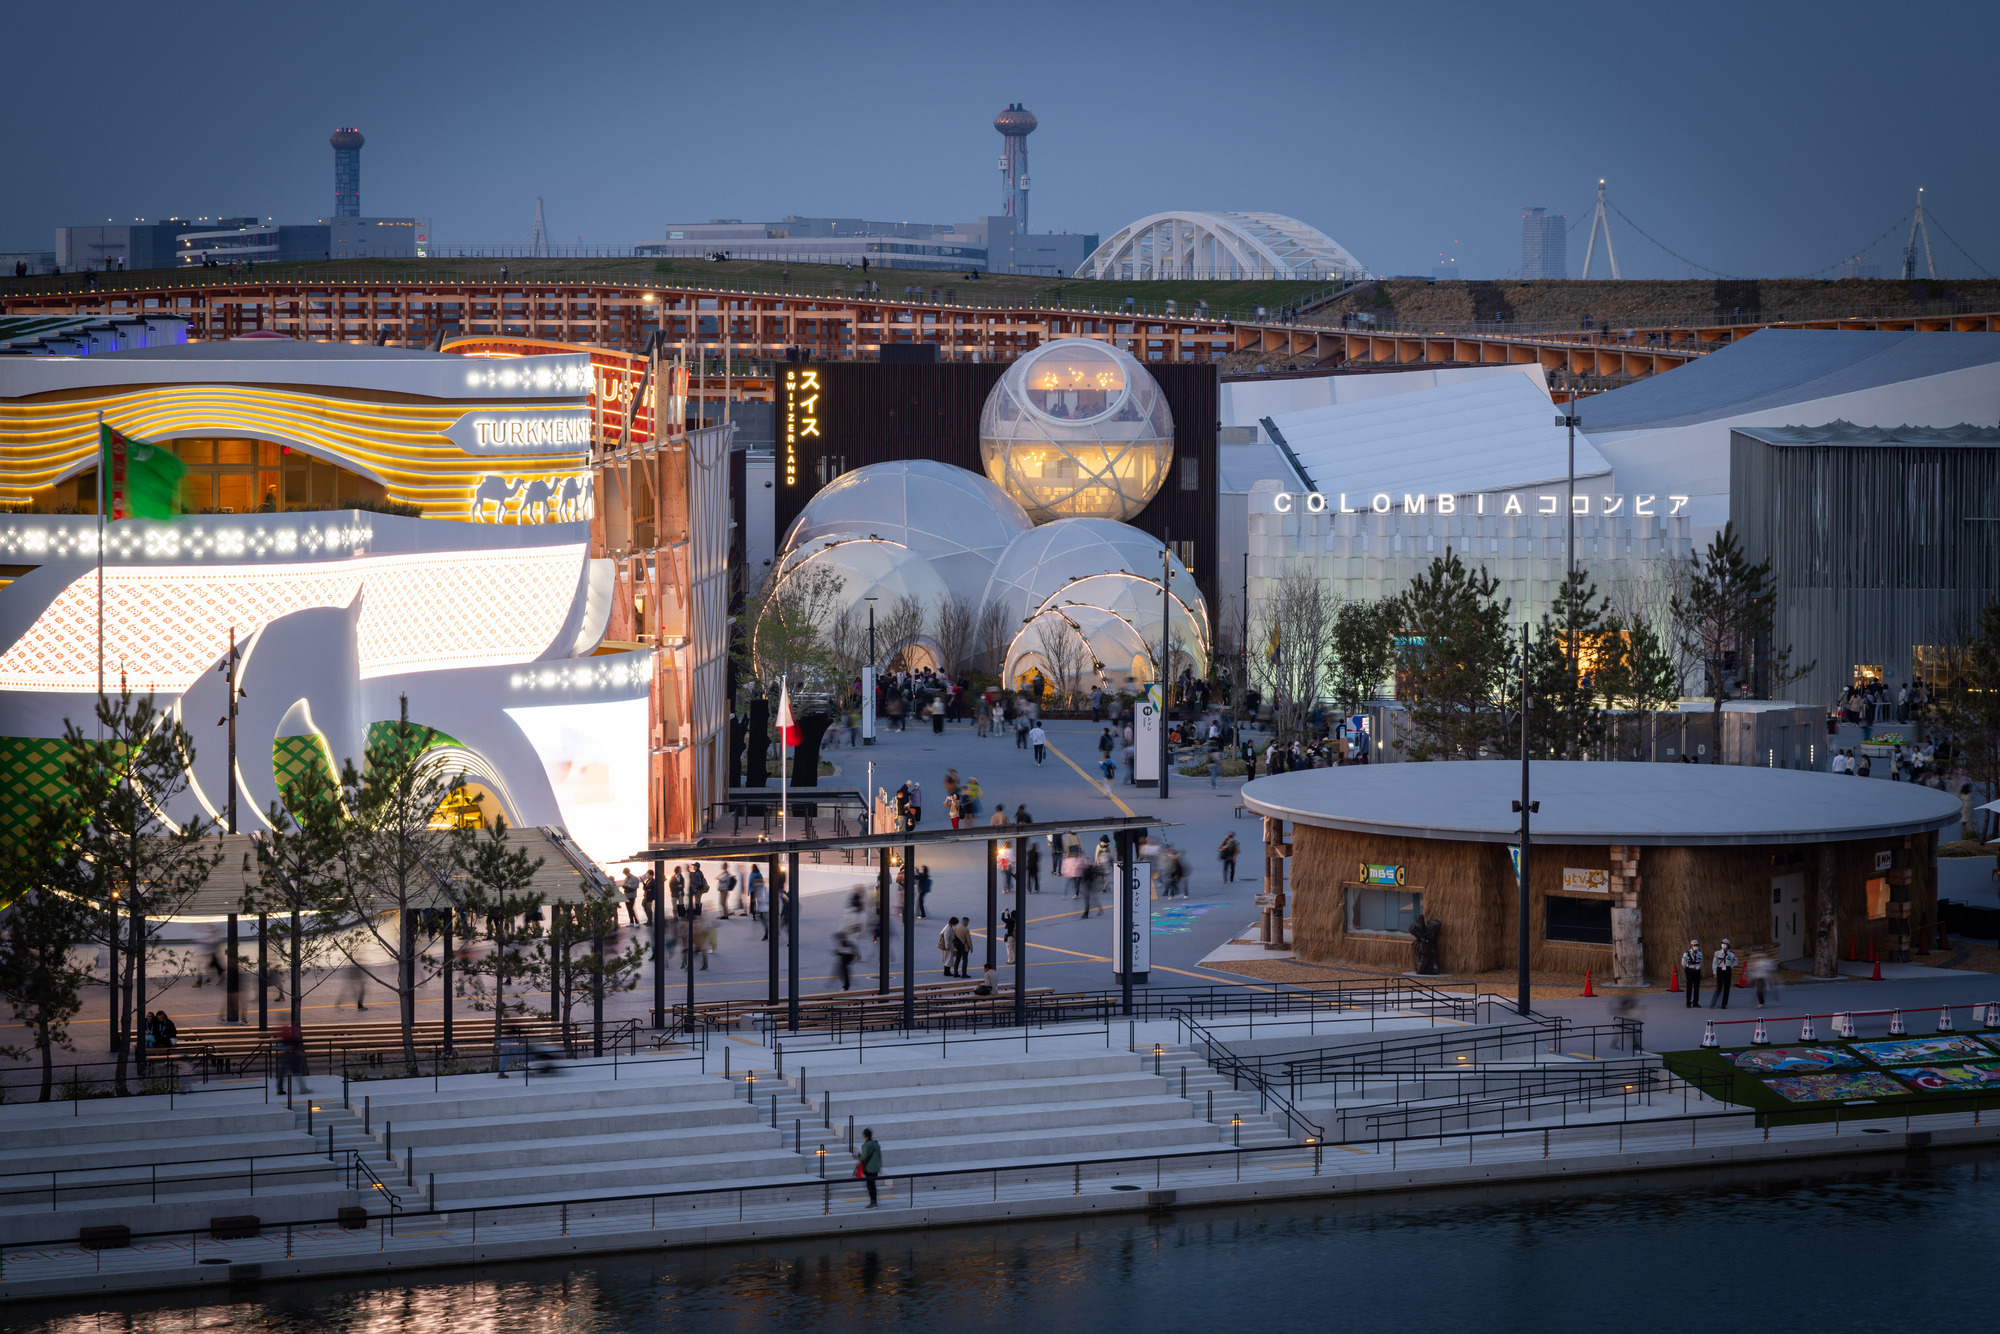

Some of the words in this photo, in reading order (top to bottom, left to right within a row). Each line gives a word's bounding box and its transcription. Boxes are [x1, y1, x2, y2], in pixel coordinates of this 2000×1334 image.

[800, 371, 820, 437] スイス
[786, 371, 796, 485] SWITZERLAND
[1274, 493, 1523, 514] COLOMBIA
[1538, 495, 1690, 515] コロンビア
